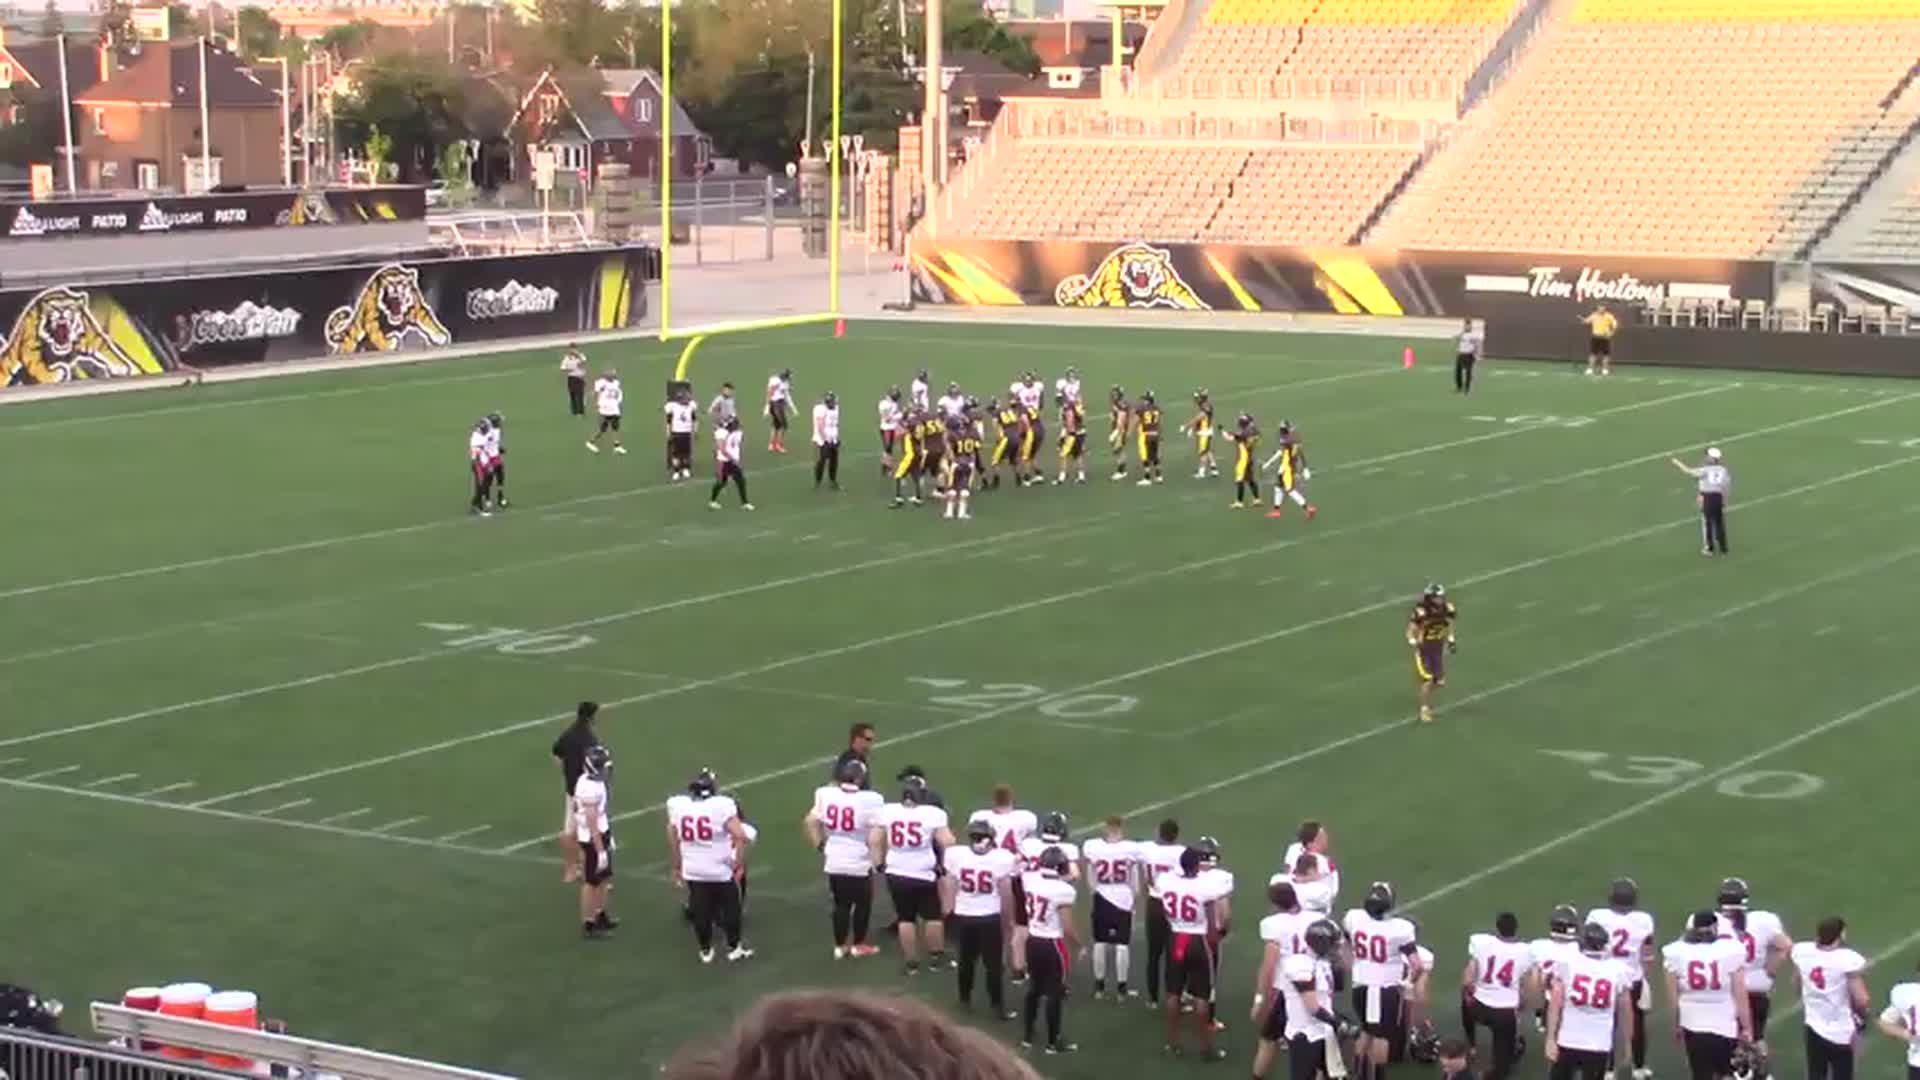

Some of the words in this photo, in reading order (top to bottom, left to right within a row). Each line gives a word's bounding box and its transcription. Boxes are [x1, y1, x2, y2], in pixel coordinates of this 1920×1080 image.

[92, 214, 128, 228] PATIO
[215, 208, 247, 222] PATIO
[1529, 267, 1573, 297] Tim
[1576, 267, 1664, 302] Hortons
[956, 438, 975, 454] 10
[925, 682, 1139, 719] 20
[1587, 754, 1825, 799] 30
[681, 815, 713, 841] 66
[826, 804, 855, 832] 98
[890, 820, 922, 847] 65
[959, 868, 994, 894] 56
[1163, 891, 1209, 923] 36
[1354, 931, 1389, 963] 60
[1482, 955, 1515, 988] 14
[1687, 960, 1721, 991] 61
[1809, 965, 1826, 990] 4
[1570, 974, 1612, 1009] 58
